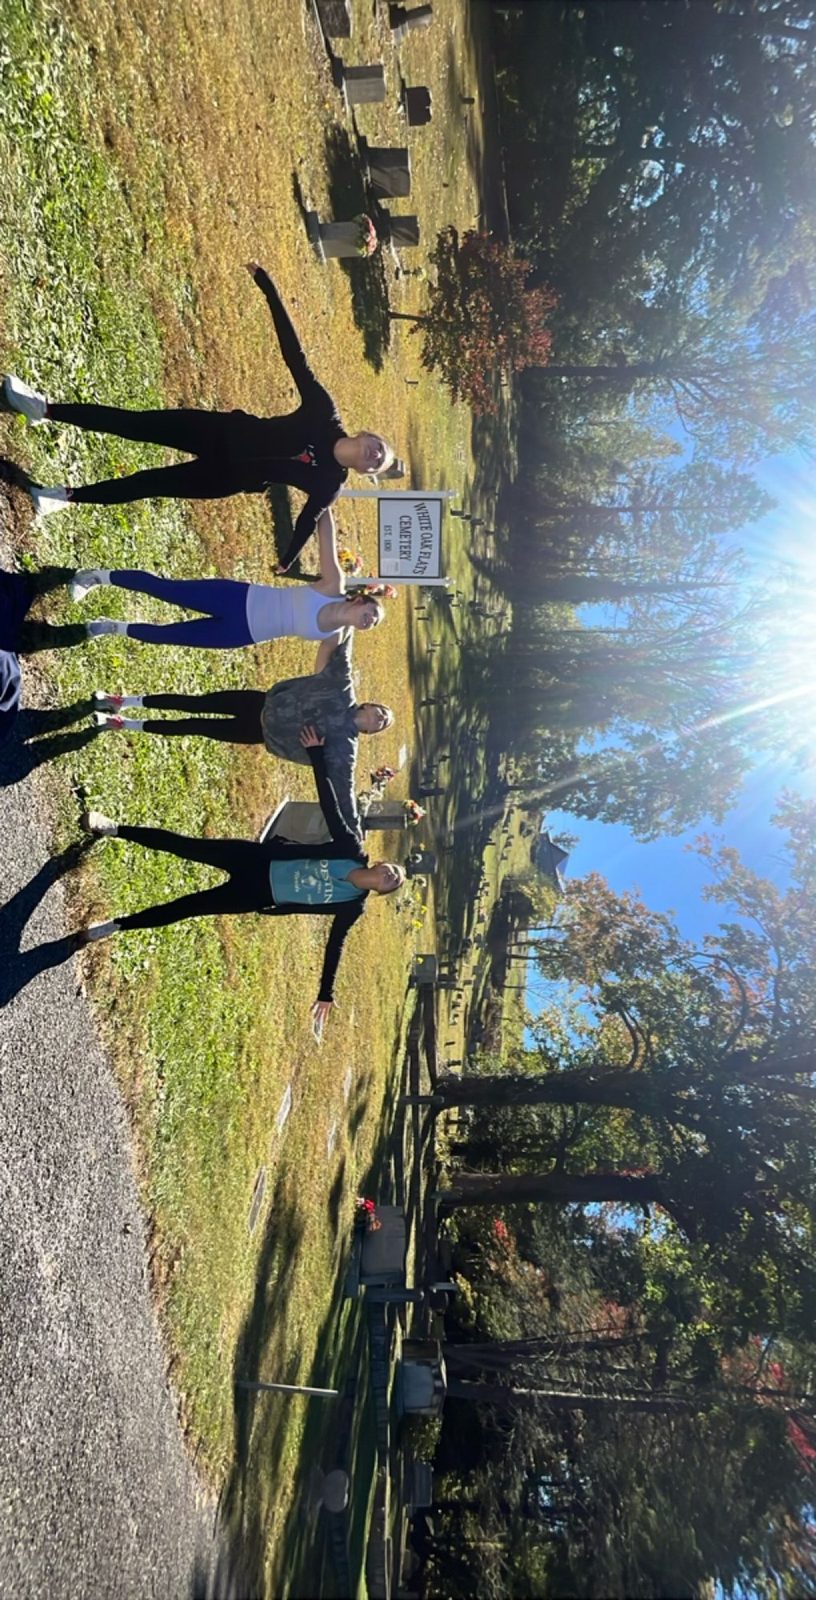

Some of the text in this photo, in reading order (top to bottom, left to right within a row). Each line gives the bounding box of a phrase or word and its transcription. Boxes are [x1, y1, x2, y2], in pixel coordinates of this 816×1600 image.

[384, 525, 392, 537] EST.
[399, 515, 412, 561] CEMETERY
[413, 503, 433, 575] WHITE OAK FLATS
[320, 859, 333, 904] DESTIN
